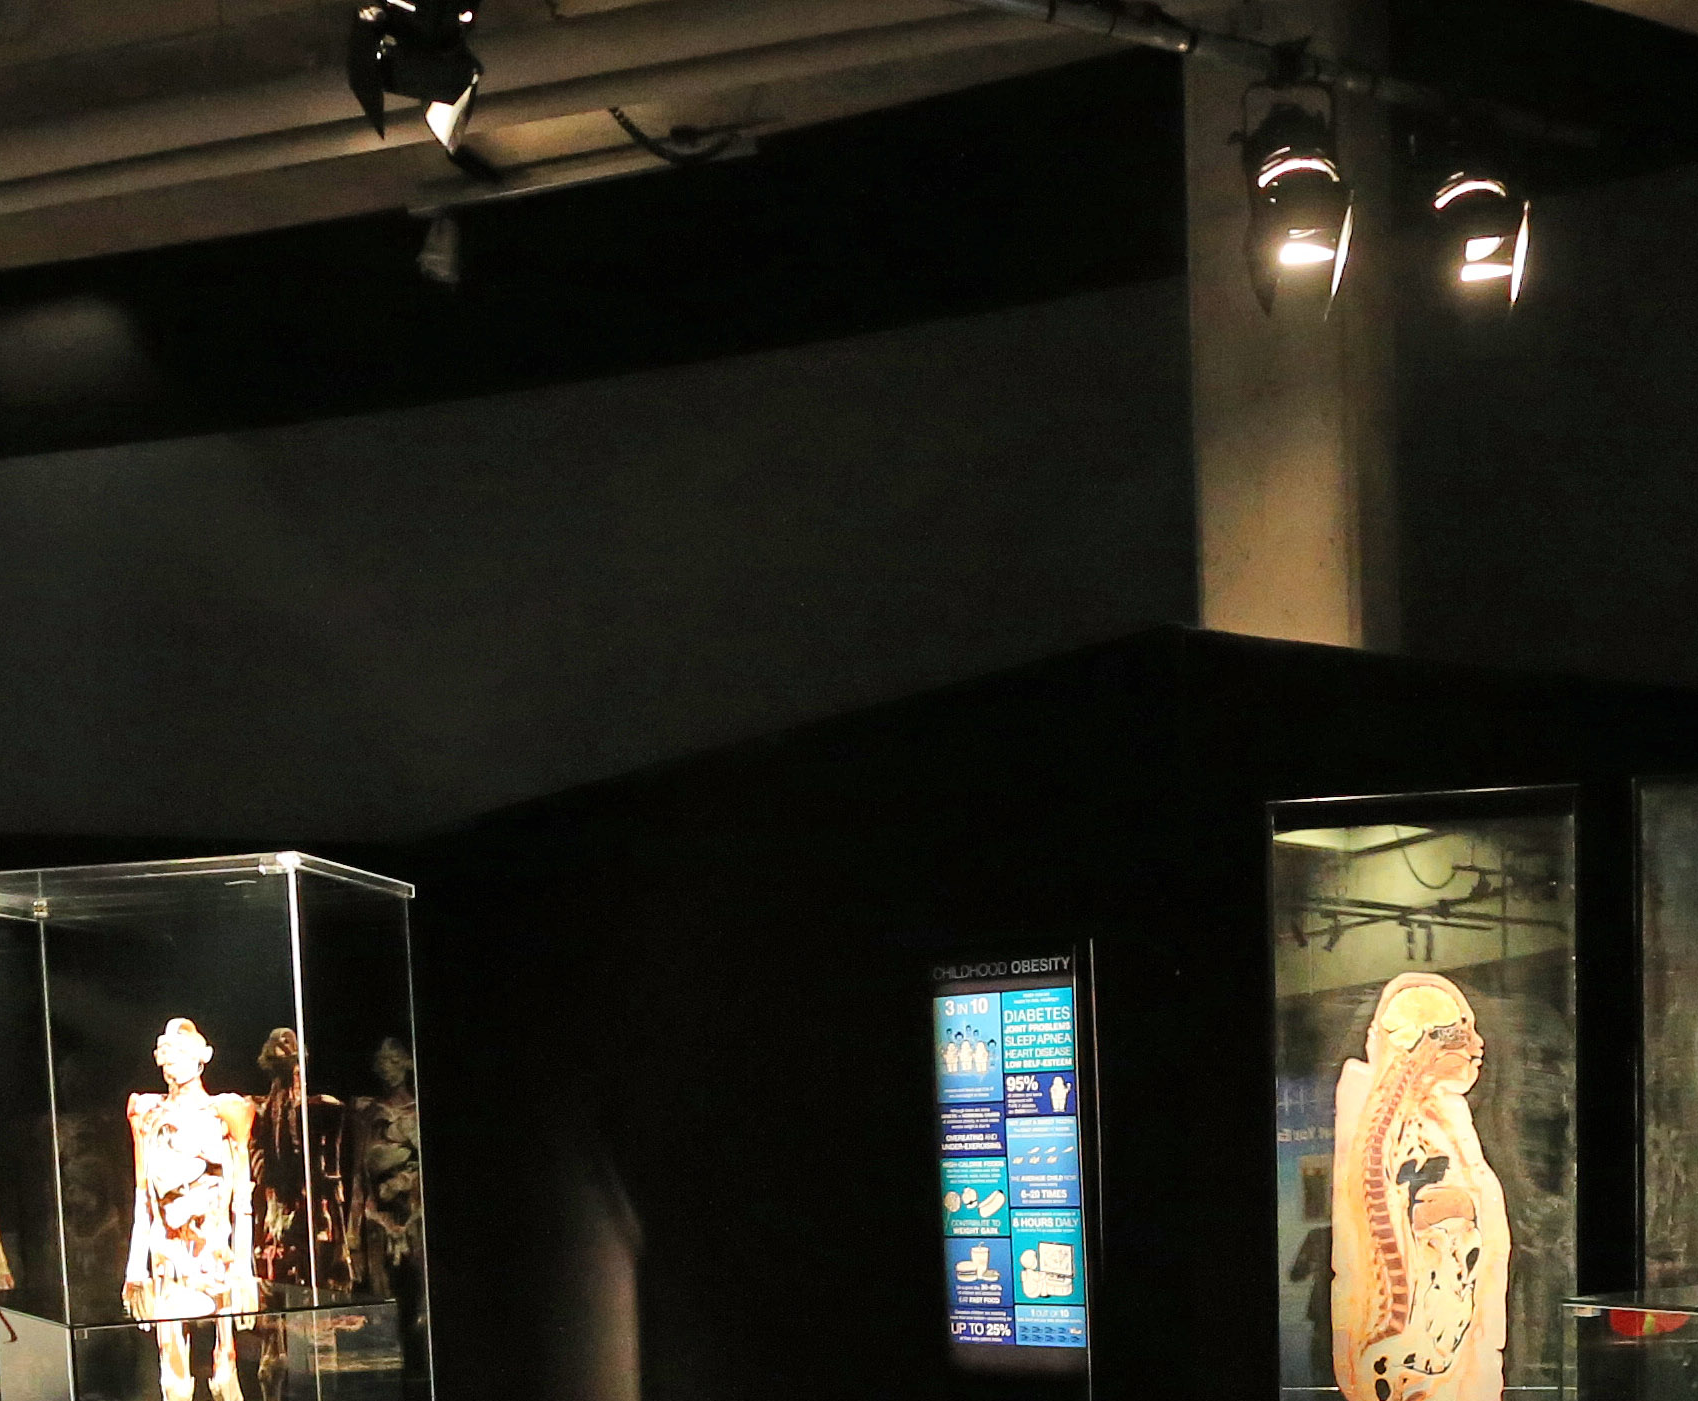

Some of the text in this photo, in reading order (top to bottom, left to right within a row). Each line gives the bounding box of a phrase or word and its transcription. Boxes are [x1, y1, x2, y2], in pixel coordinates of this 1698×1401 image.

[933, 956, 1070, 980] CHILDHOOD OBESITY
[945, 997, 988, 1016] 3 IN 10
[1004, 1006, 1071, 1023] DIABETES
[1004, 1021, 1071, 1034] JOINT PROBLEMS
[1005, 1032, 1071, 1046] SLEEP APNEA
[1005, 1046, 1072, 1059] HEART DISEASE
[1005, 1060, 1022, 1069] LOW
[1006, 1075, 1039, 1092] 95%
[1042, 1189, 1068, 1198] TIMES
[1020, 1217, 1054, 1228] HOURS
[1055, 1217, 1079, 1227] DAILY
[951, 1322, 1012, 1337] UP TO 25%
